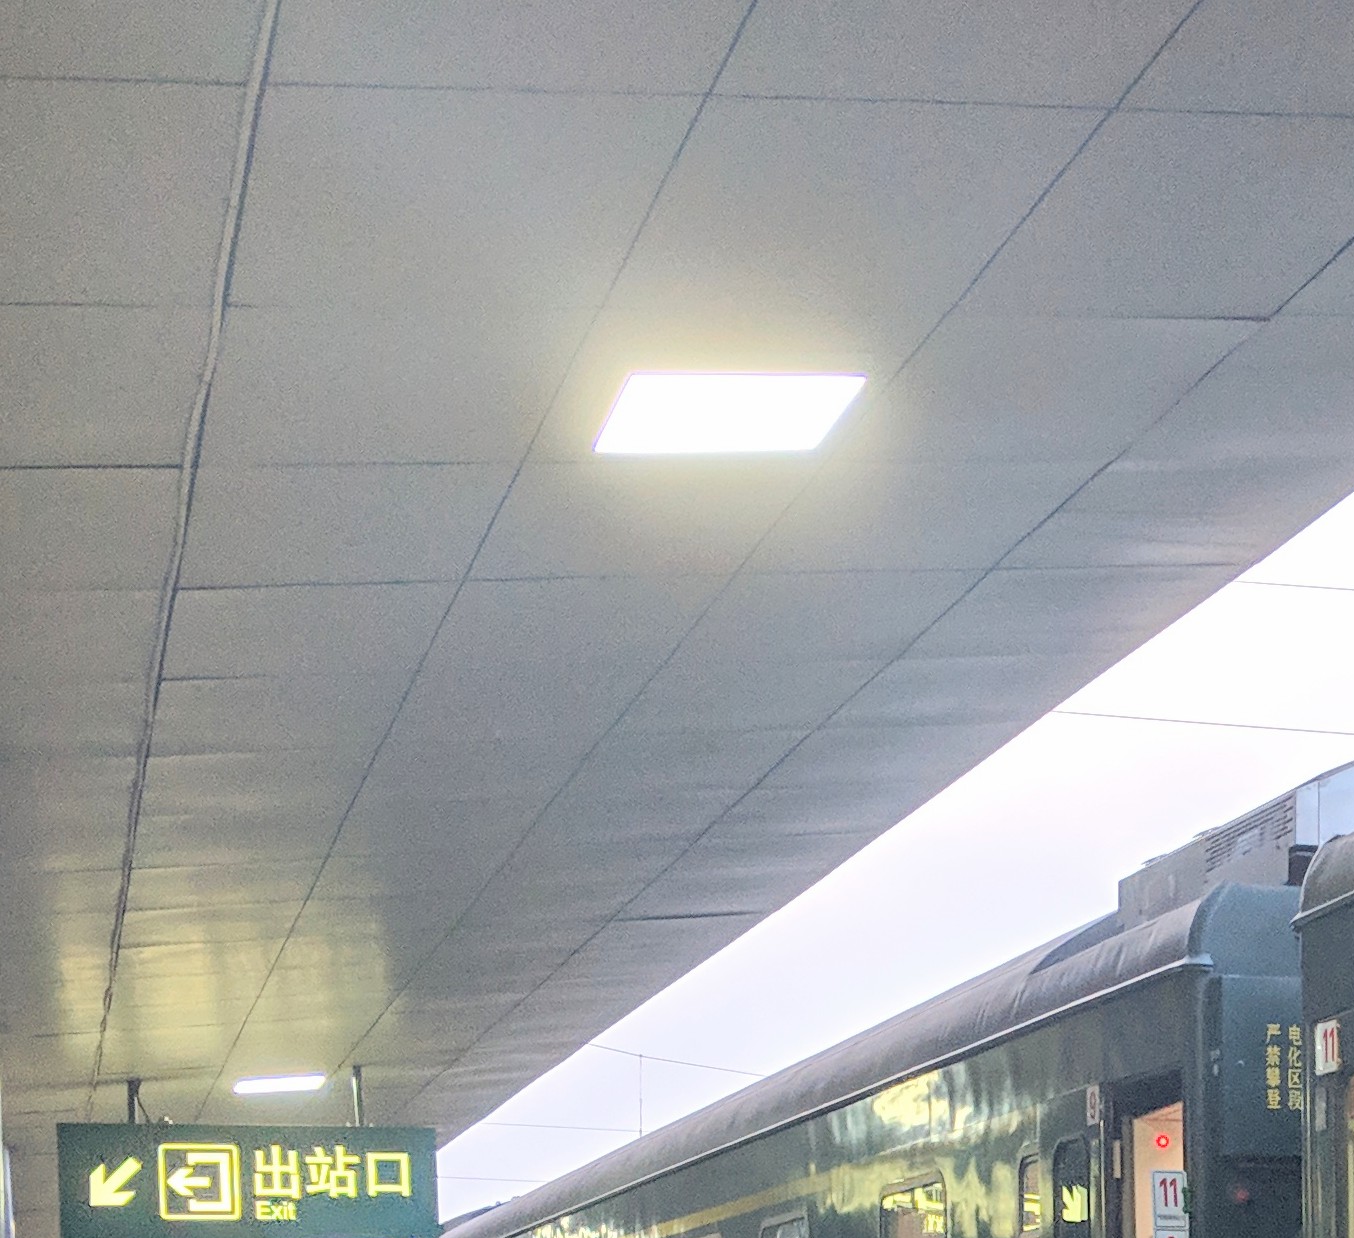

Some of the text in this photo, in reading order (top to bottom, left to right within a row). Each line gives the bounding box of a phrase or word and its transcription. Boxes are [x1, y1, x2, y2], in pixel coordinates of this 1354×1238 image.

[1265, 1023, 1281, 1109] 严禁攀登
[1323, 1027, 1335, 1062] 11
[1287, 1024, 1302, 1110] 电化区段
[254, 1145, 411, 1199] 出站口
[1159, 1177, 1178, 1207] 11
[255, 1200, 297, 1220] Exit
